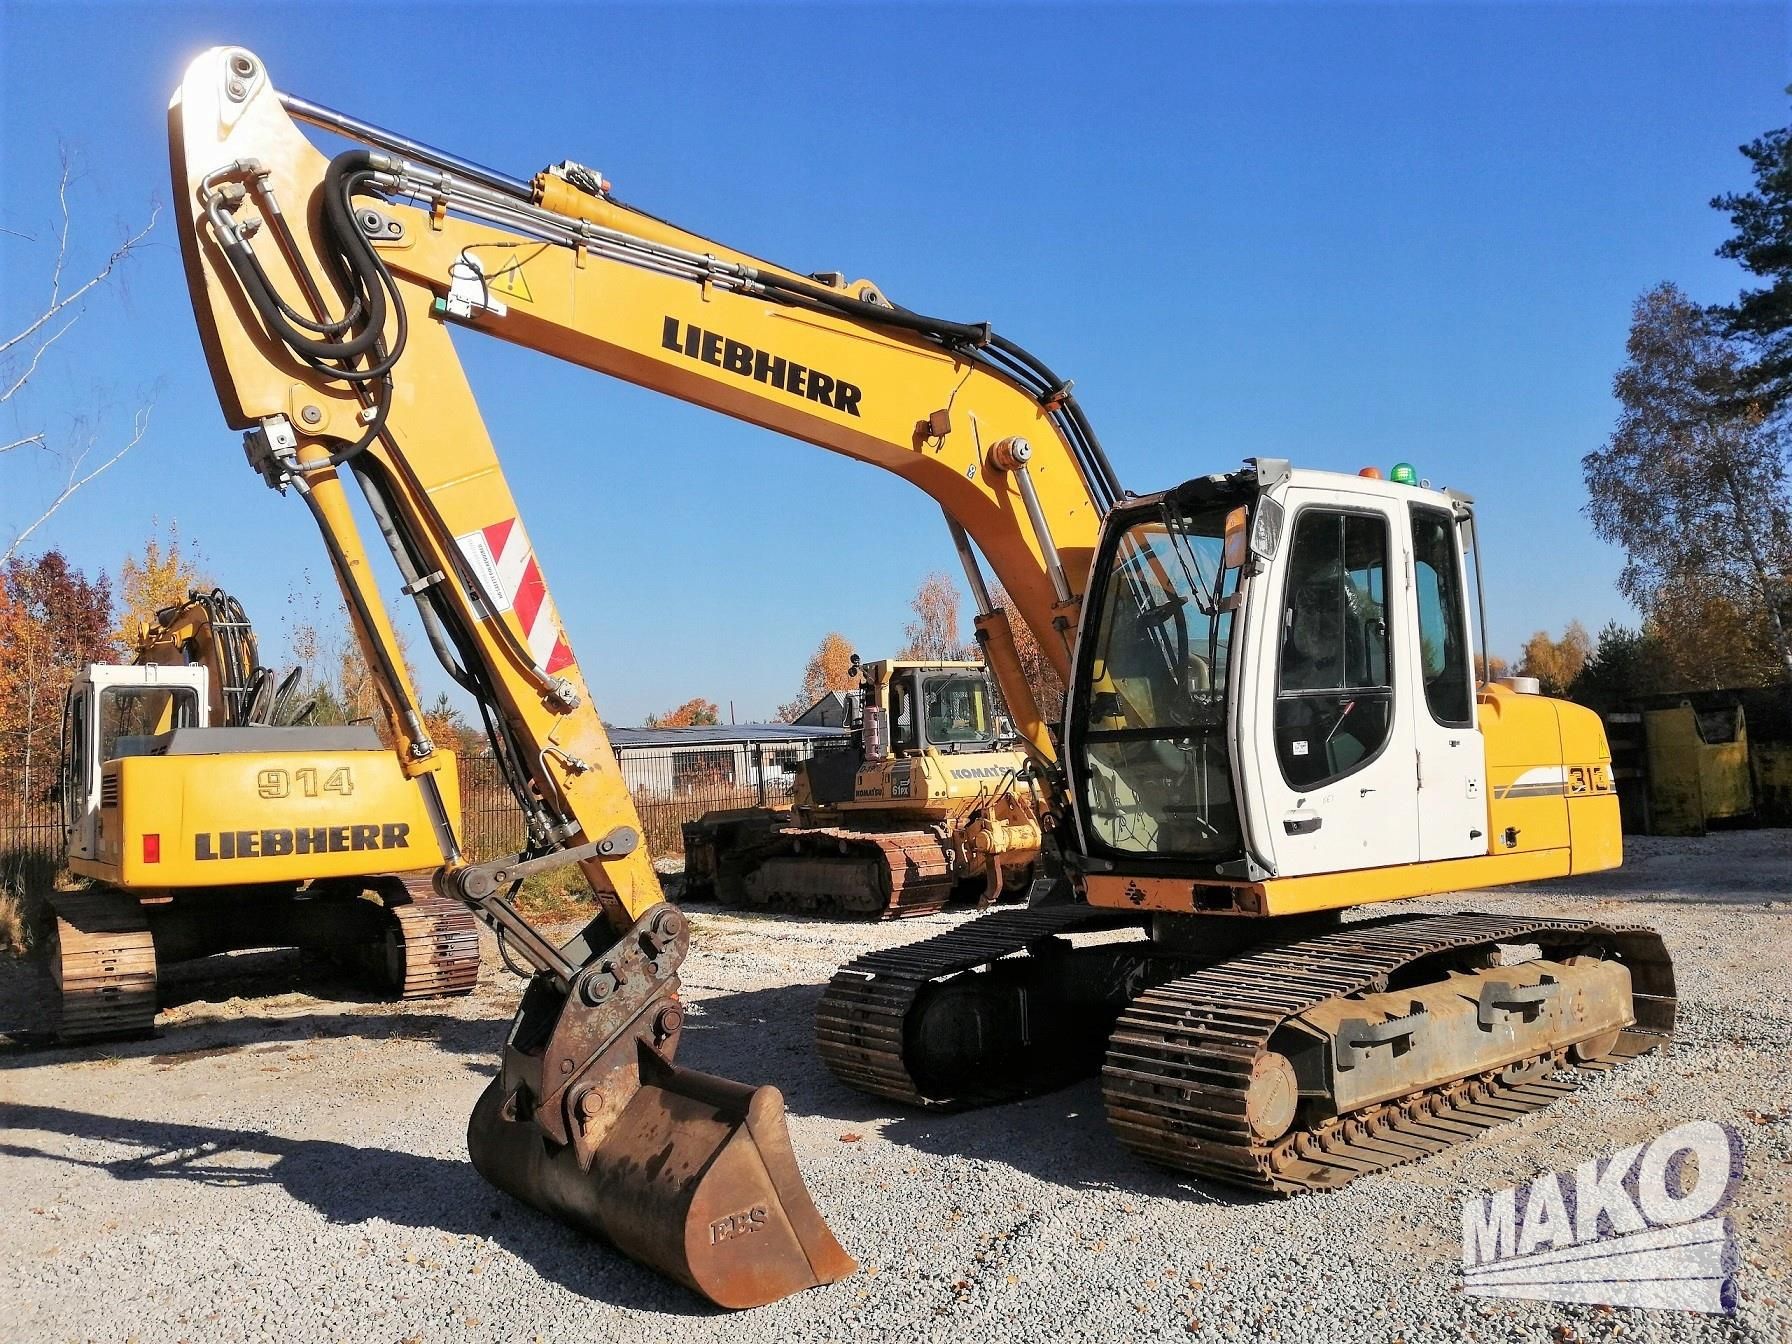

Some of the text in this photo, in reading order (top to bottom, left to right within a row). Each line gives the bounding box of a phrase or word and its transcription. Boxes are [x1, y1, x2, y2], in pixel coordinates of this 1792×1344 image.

[662, 315, 862, 417] LIEBHERR
[257, 767, 354, 799] 914
[195, 822, 410, 861] LIEBHERR
